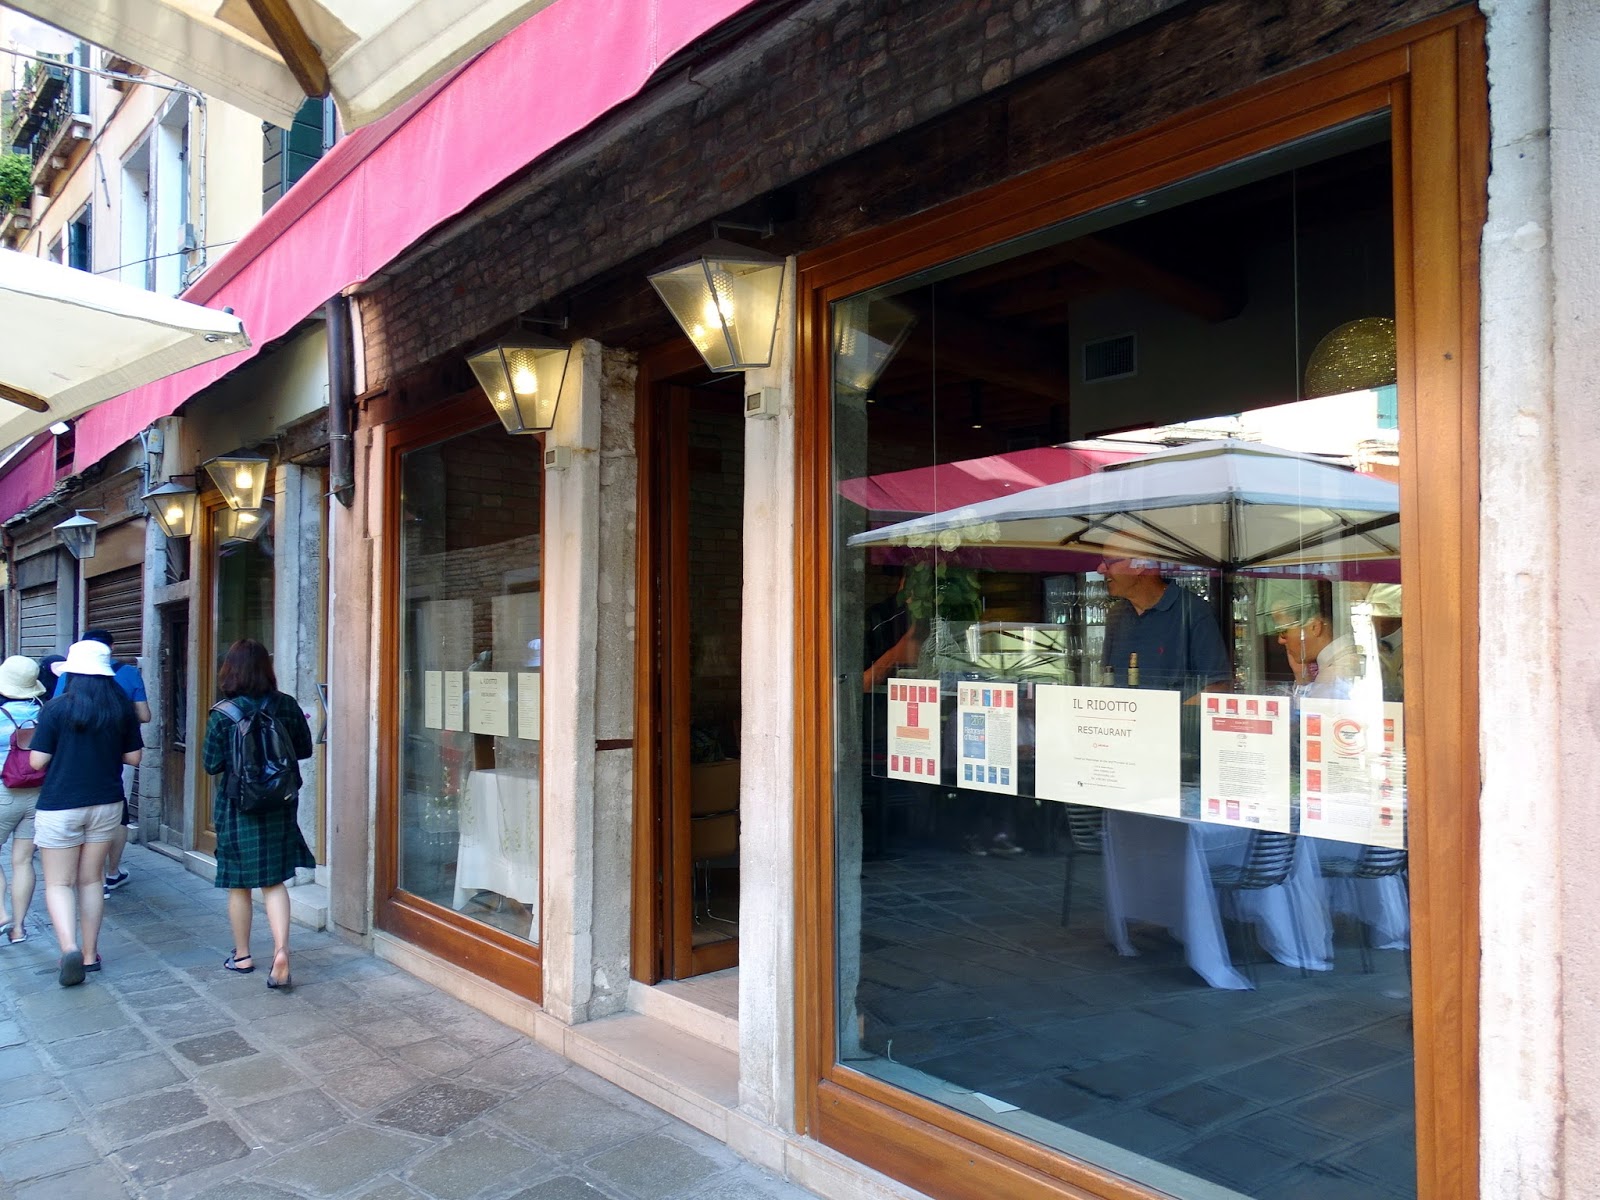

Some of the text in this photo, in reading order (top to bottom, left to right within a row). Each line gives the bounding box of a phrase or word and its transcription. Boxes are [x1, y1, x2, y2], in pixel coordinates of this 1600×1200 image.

[1073, 698, 1137, 712] IL RIDOTTO
[1077, 725, 1132, 737] RESTAURANT
